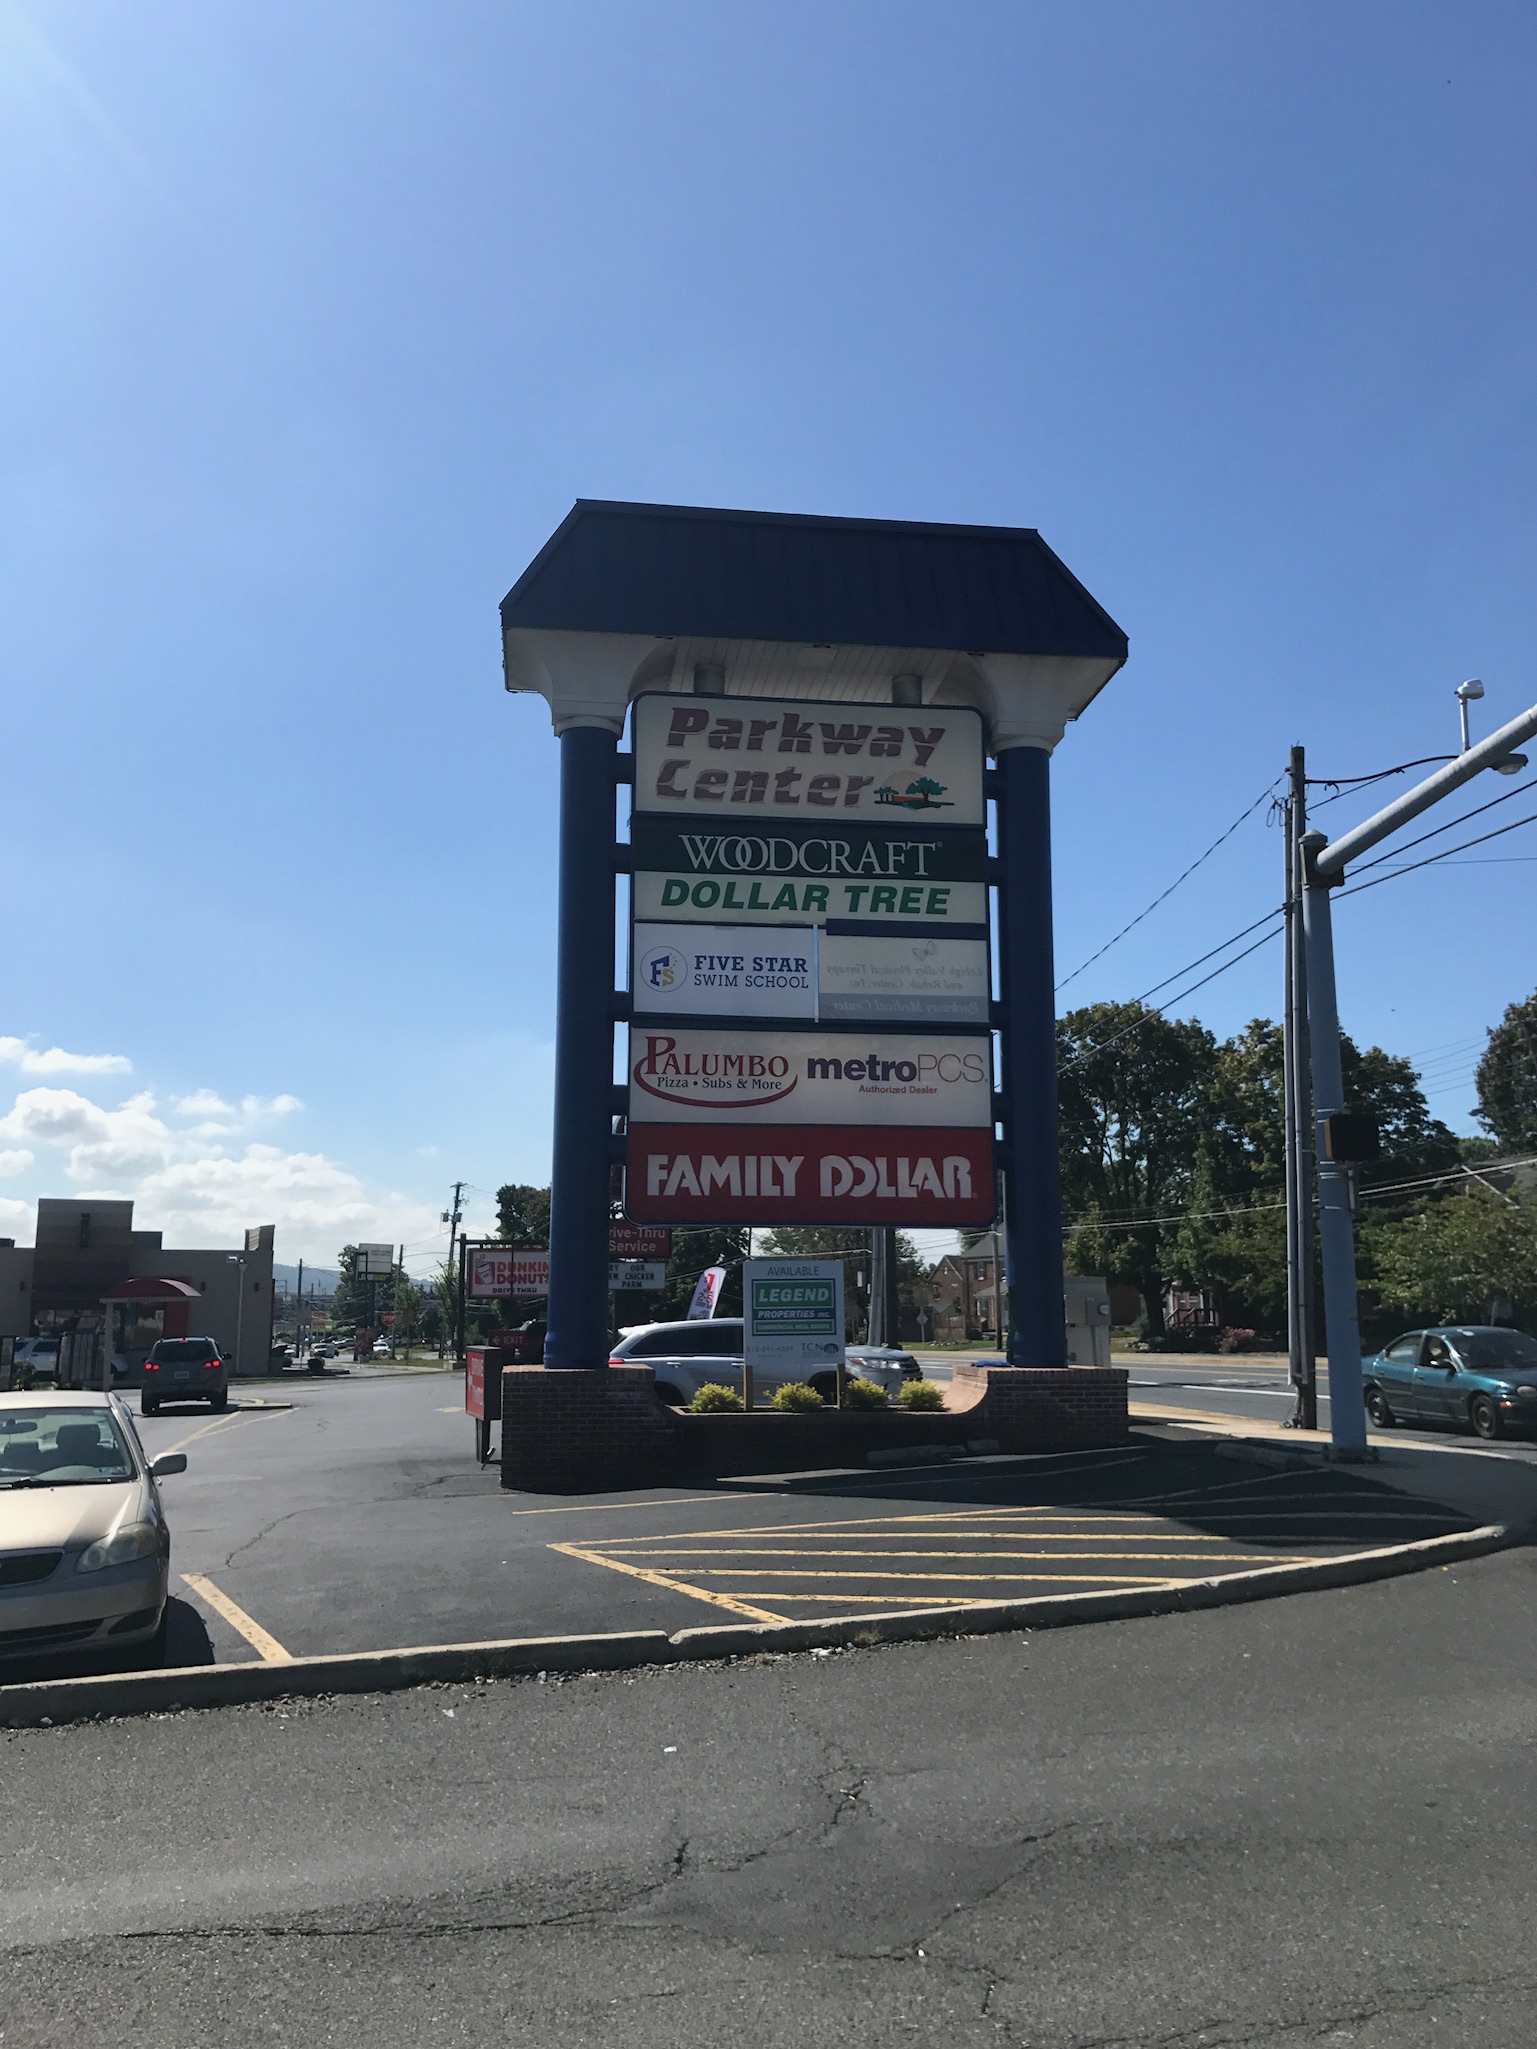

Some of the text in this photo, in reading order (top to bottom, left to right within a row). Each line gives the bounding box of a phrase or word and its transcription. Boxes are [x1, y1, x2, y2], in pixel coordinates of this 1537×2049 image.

[666, 706, 946, 767] Parkway
[655, 757, 875, 808] Center
[678, 834, 937, 876] WOODCRAFT
[661, 878, 951, 915] DOLLAR TREE
[694, 954, 808, 973] FIVE STAR
[694, 973, 809, 989] SWIM SCHOOL
[657, 1076, 782, 1090] Pizza Subs & More
[858, 1084, 938, 1094] Authorized Dealer
[647, 1154, 972, 1199] FAMILY DOLLAR
[609, 1228, 665, 1238] rive-Thru
[609, 1240, 656, 1252] Service
[609, 1264, 619, 1272] RY
[767, 1266, 820, 1276] AVAILABLE
[758, 1288, 830, 1302] LEGEND
[757, 1310, 815, 1319] PROPERTIES
[504, 1336, 525, 1345] EXIT
[800, 1343, 824, 1352] TCN
